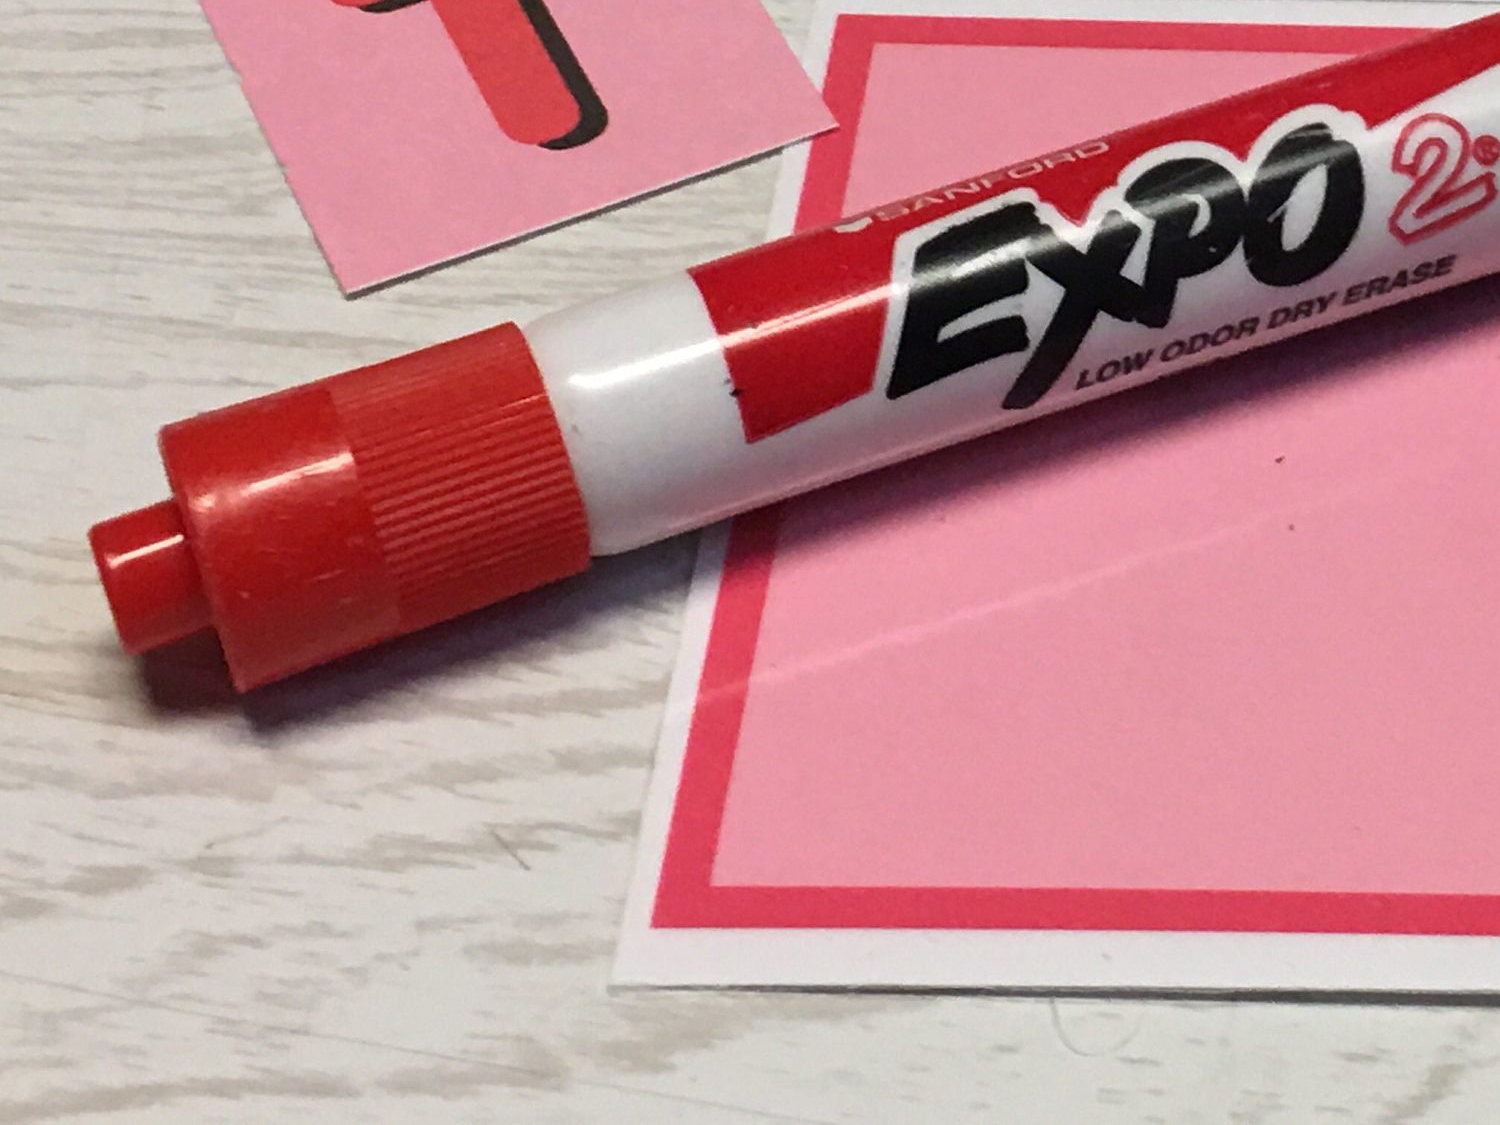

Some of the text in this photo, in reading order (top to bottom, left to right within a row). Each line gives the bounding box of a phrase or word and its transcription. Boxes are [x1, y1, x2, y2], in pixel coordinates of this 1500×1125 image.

[877, 139, 1110, 221] SANFORD
[886, 121, 1366, 409] EXPO
[1075, 254, 1457, 391] LOW ODOR DRY ERASE
